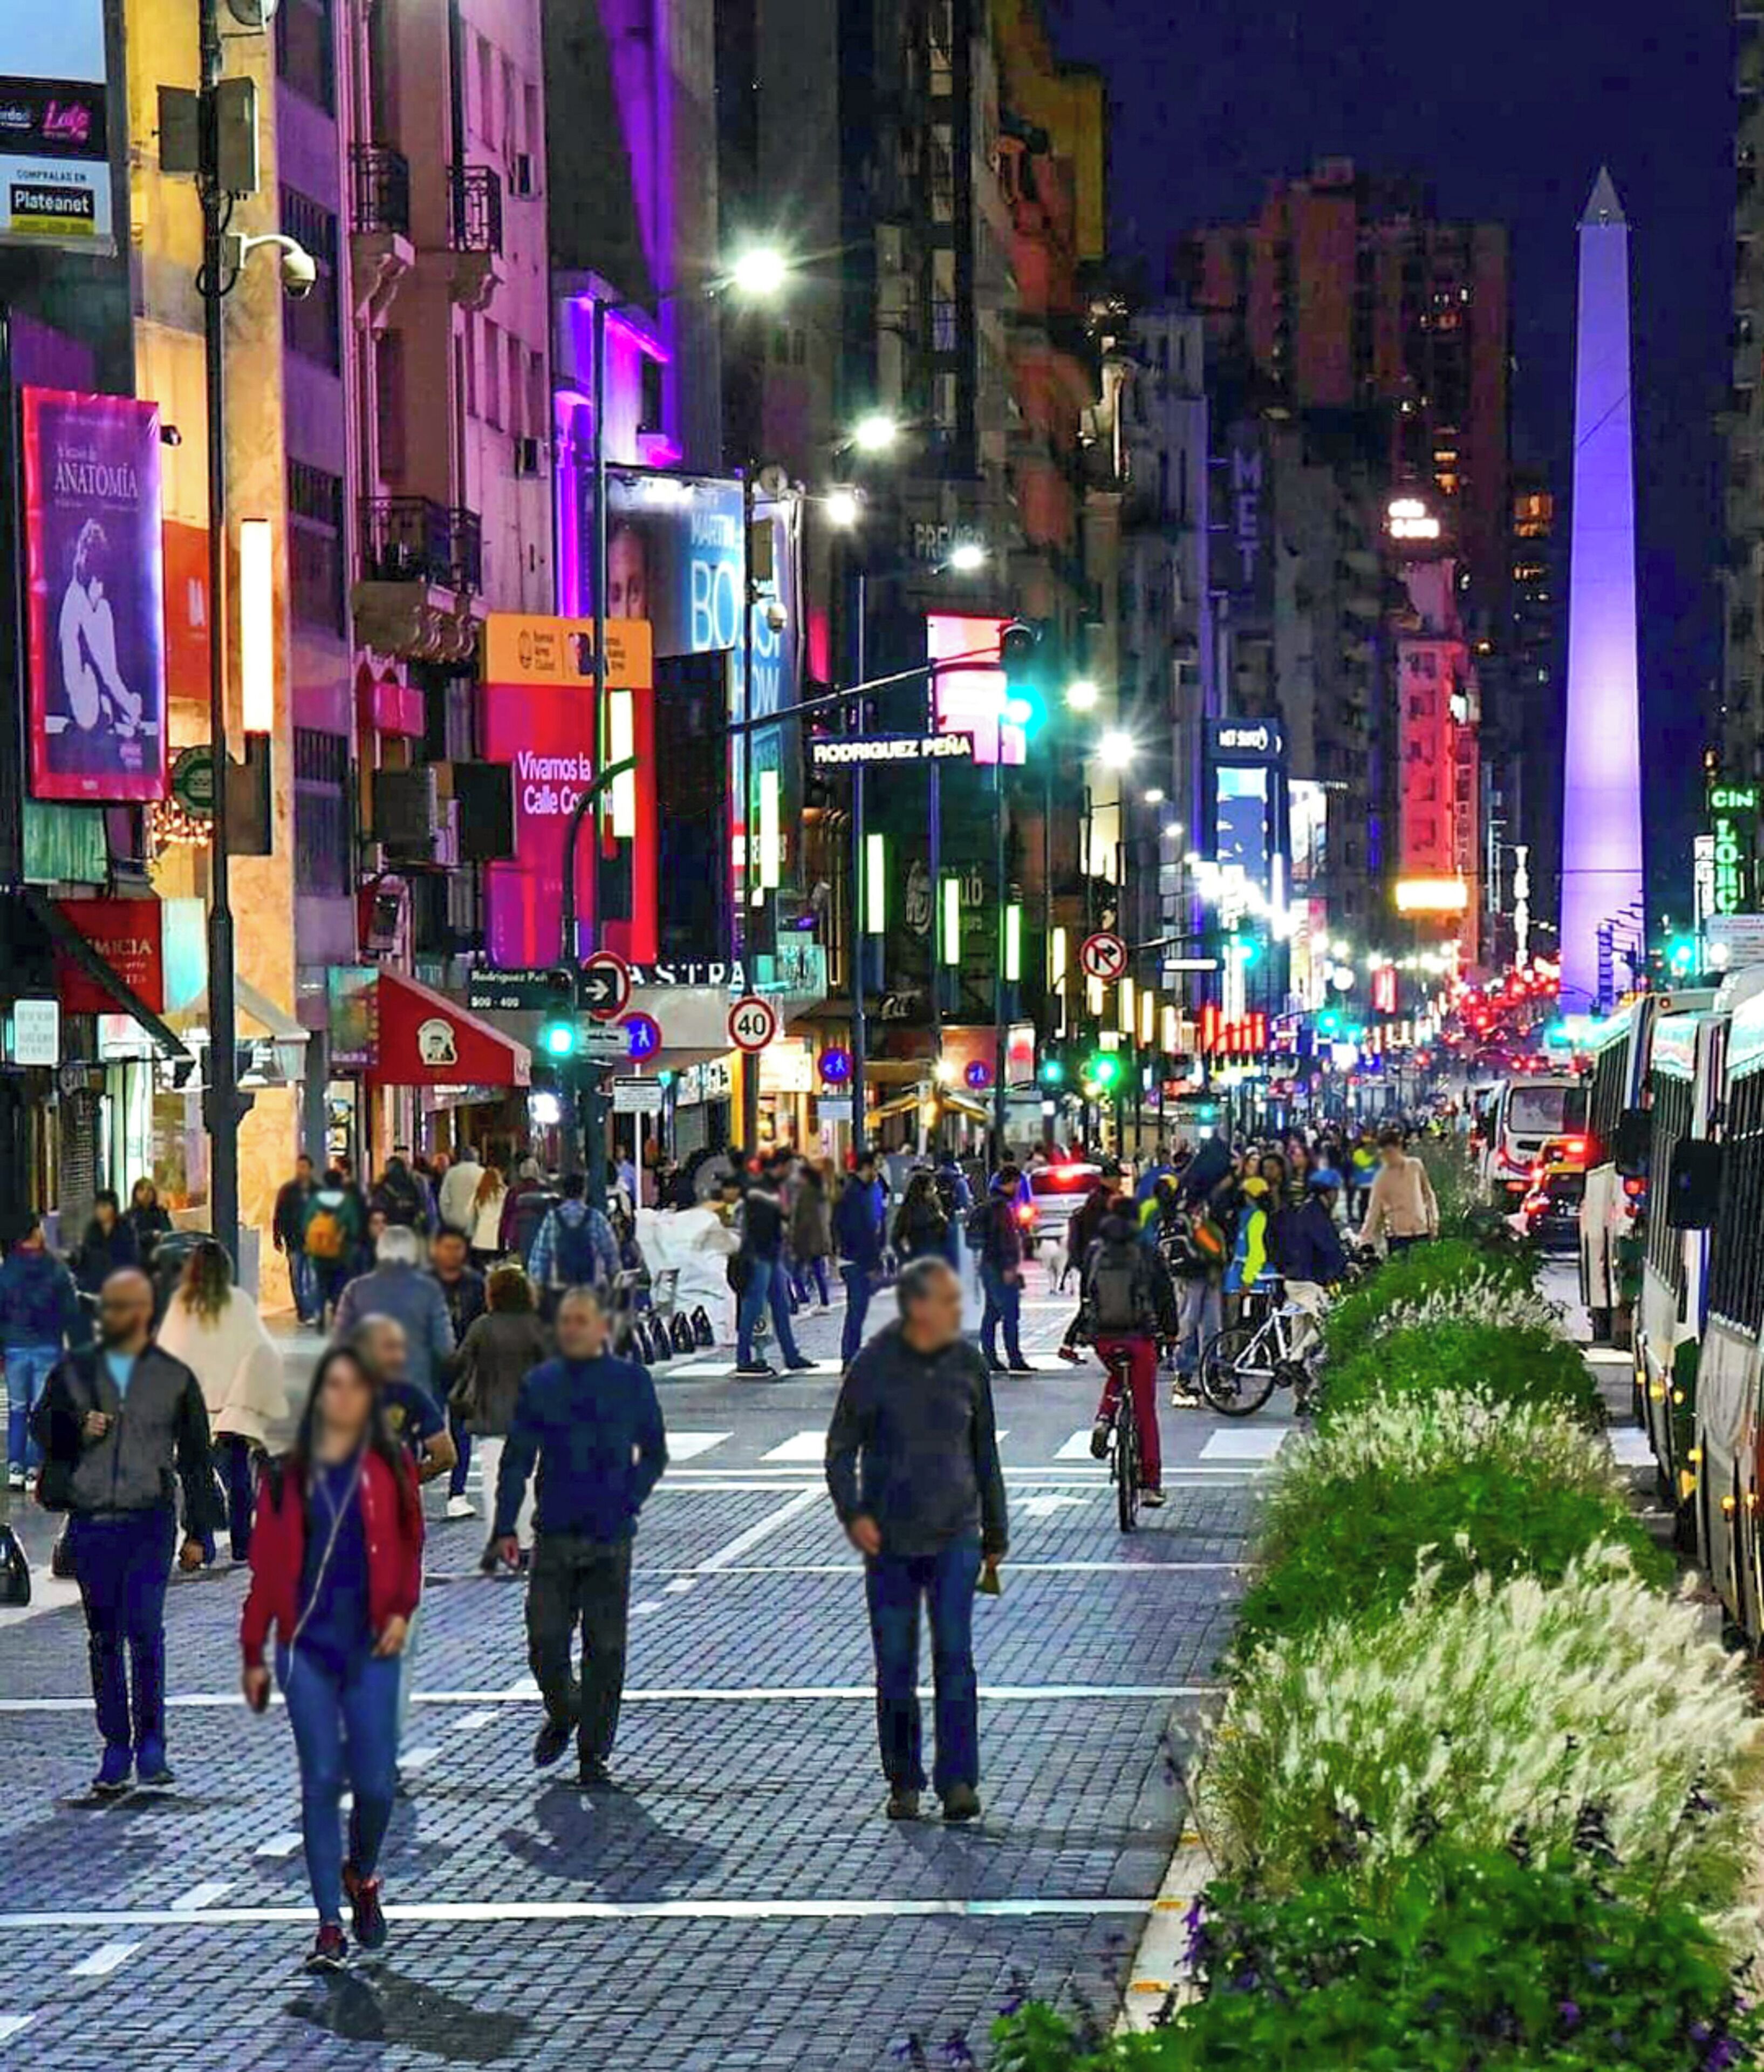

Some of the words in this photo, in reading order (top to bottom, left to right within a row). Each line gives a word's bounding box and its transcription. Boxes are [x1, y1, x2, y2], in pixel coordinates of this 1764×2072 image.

[15, 190, 90, 213] Plateanet
[813, 740, 918, 762] RODRIGUEZ
[922, 734, 971, 756] PEÑA
[518, 751, 577, 781] Vivamos
[579, 751, 591, 781] la
[524, 785, 558, 815] Calle
[738, 1013, 766, 1035] 40
